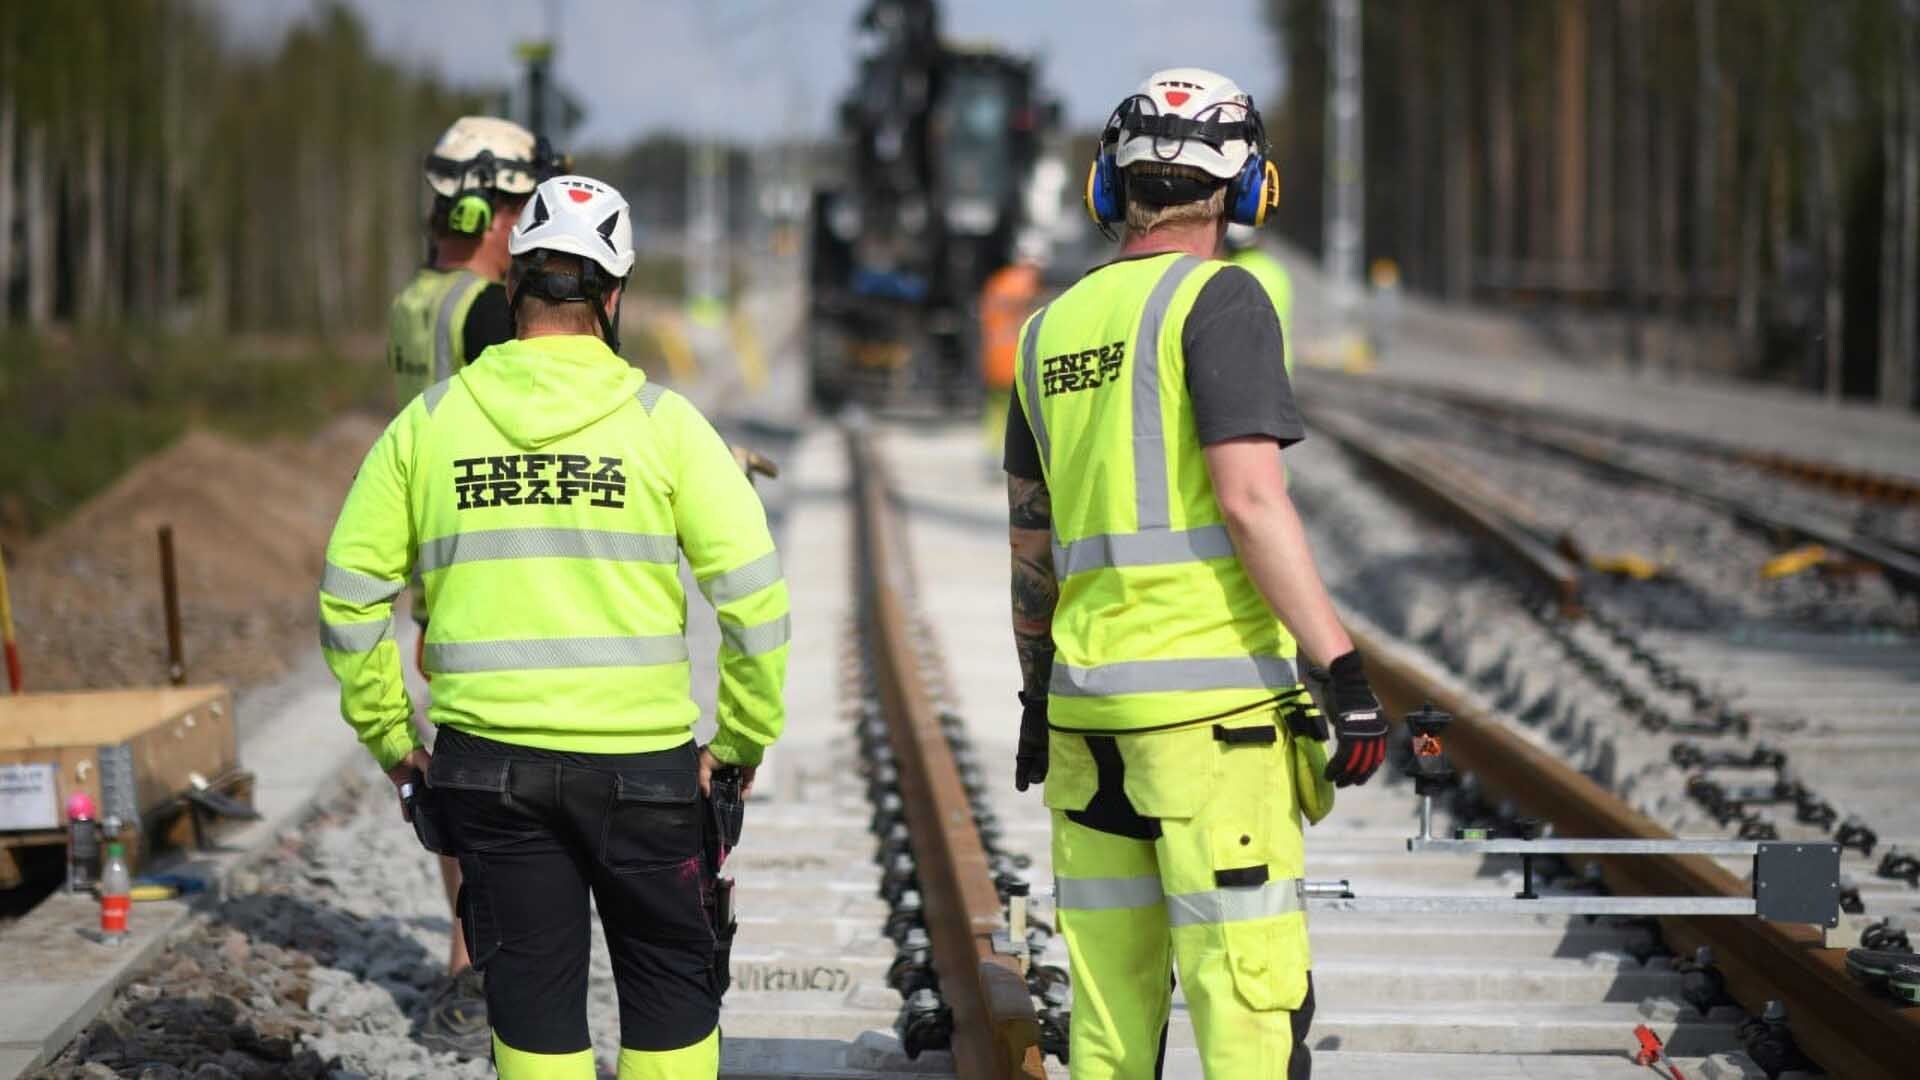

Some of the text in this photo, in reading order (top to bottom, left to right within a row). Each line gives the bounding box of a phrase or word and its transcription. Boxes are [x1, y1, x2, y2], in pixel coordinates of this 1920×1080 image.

[1043, 341, 1125, 375] INFRA
[453, 454, 626, 484] INFRA
[455, 479, 626, 510] KRAFT
